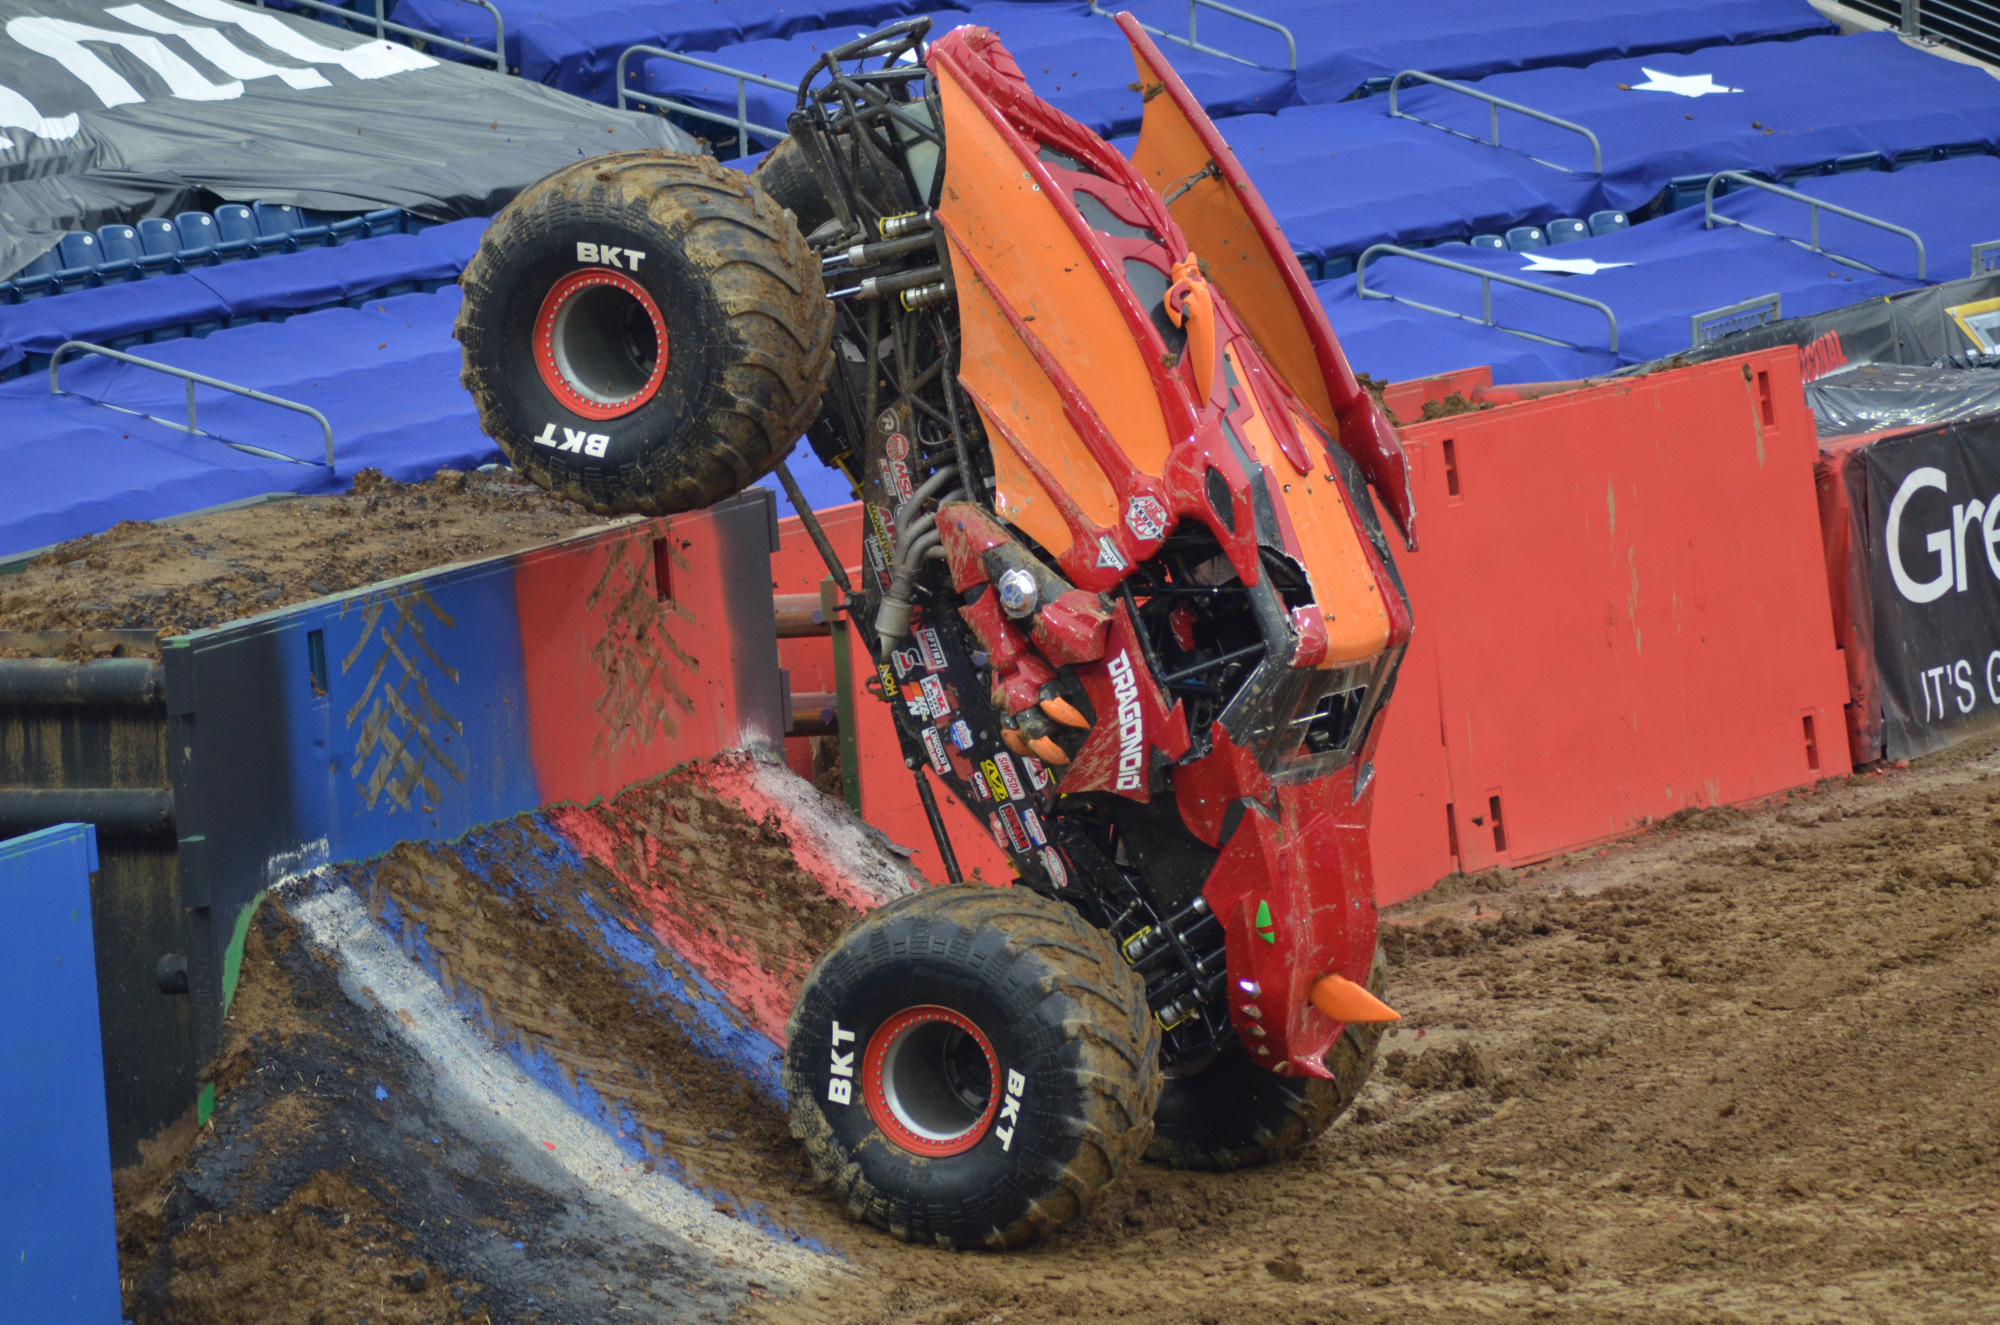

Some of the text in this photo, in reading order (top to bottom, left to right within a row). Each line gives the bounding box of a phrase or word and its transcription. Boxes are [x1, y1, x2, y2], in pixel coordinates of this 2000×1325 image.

[576, 241, 646, 273] BKT
[533, 422, 611, 458] BKT
[1130, 497, 1164, 540] BAKUGAN
[865, 538, 887, 571] Holley
[1097, 536, 1124, 571] MONSTER
[1099, 549, 1113, 565] JAM
[924, 630, 943, 665] OPTIMA
[1920, 658, 1976, 723] IT'S
[1107, 647, 1143, 791] DRAGONOID
[925, 739, 942, 770] WELDERS
[927, 728, 947, 764] LINCOLN
[972, 771, 989, 797] Coan
[997, 755, 1021, 796] SIMPSON
[1003, 805, 1028, 849] DERALE
[828, 1021, 855, 1105] BKT
[995, 1068, 1025, 1152] BKT
